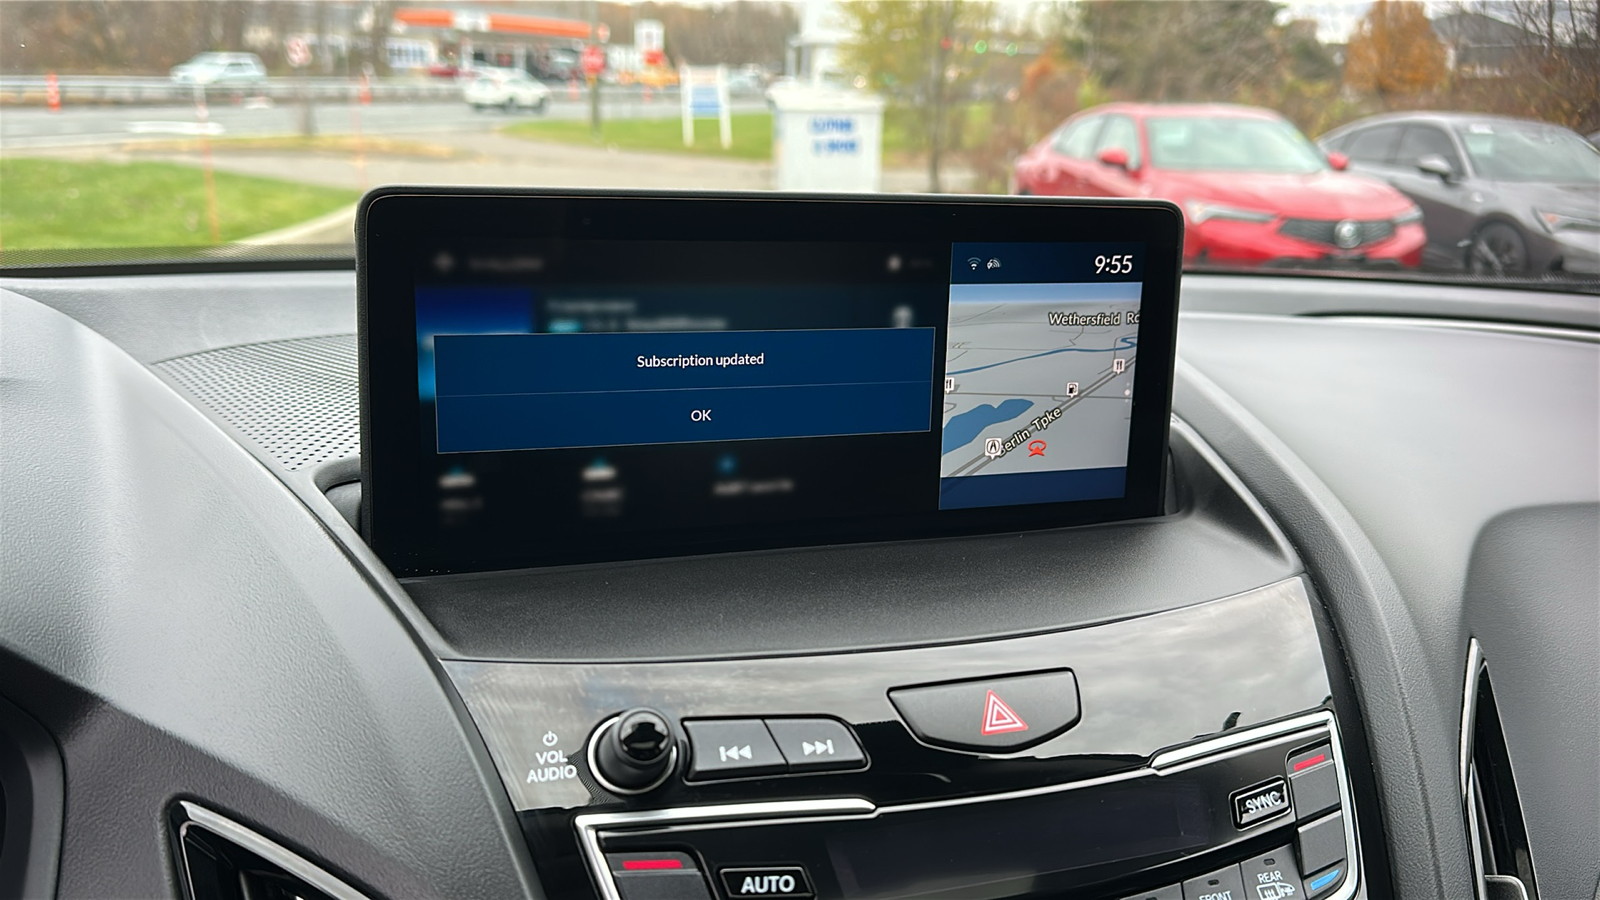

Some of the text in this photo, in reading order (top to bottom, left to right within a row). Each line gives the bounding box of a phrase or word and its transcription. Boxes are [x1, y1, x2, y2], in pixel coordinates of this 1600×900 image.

[1094, 255, 1133, 274] 9:55
[1049, 312, 1121, 326] Wethersfield
[637, 352, 765, 369] Subscription updated
[690, 408, 712, 422] OK
[1032, 408, 1062, 431] Tpke
[535, 750, 568, 765] VOL
[526, 765, 577, 784] AUDIO
[1245, 791, 1282, 814] SYNC
[740, 875, 796, 894] AUTO
[1257, 870, 1283, 884] REAR
